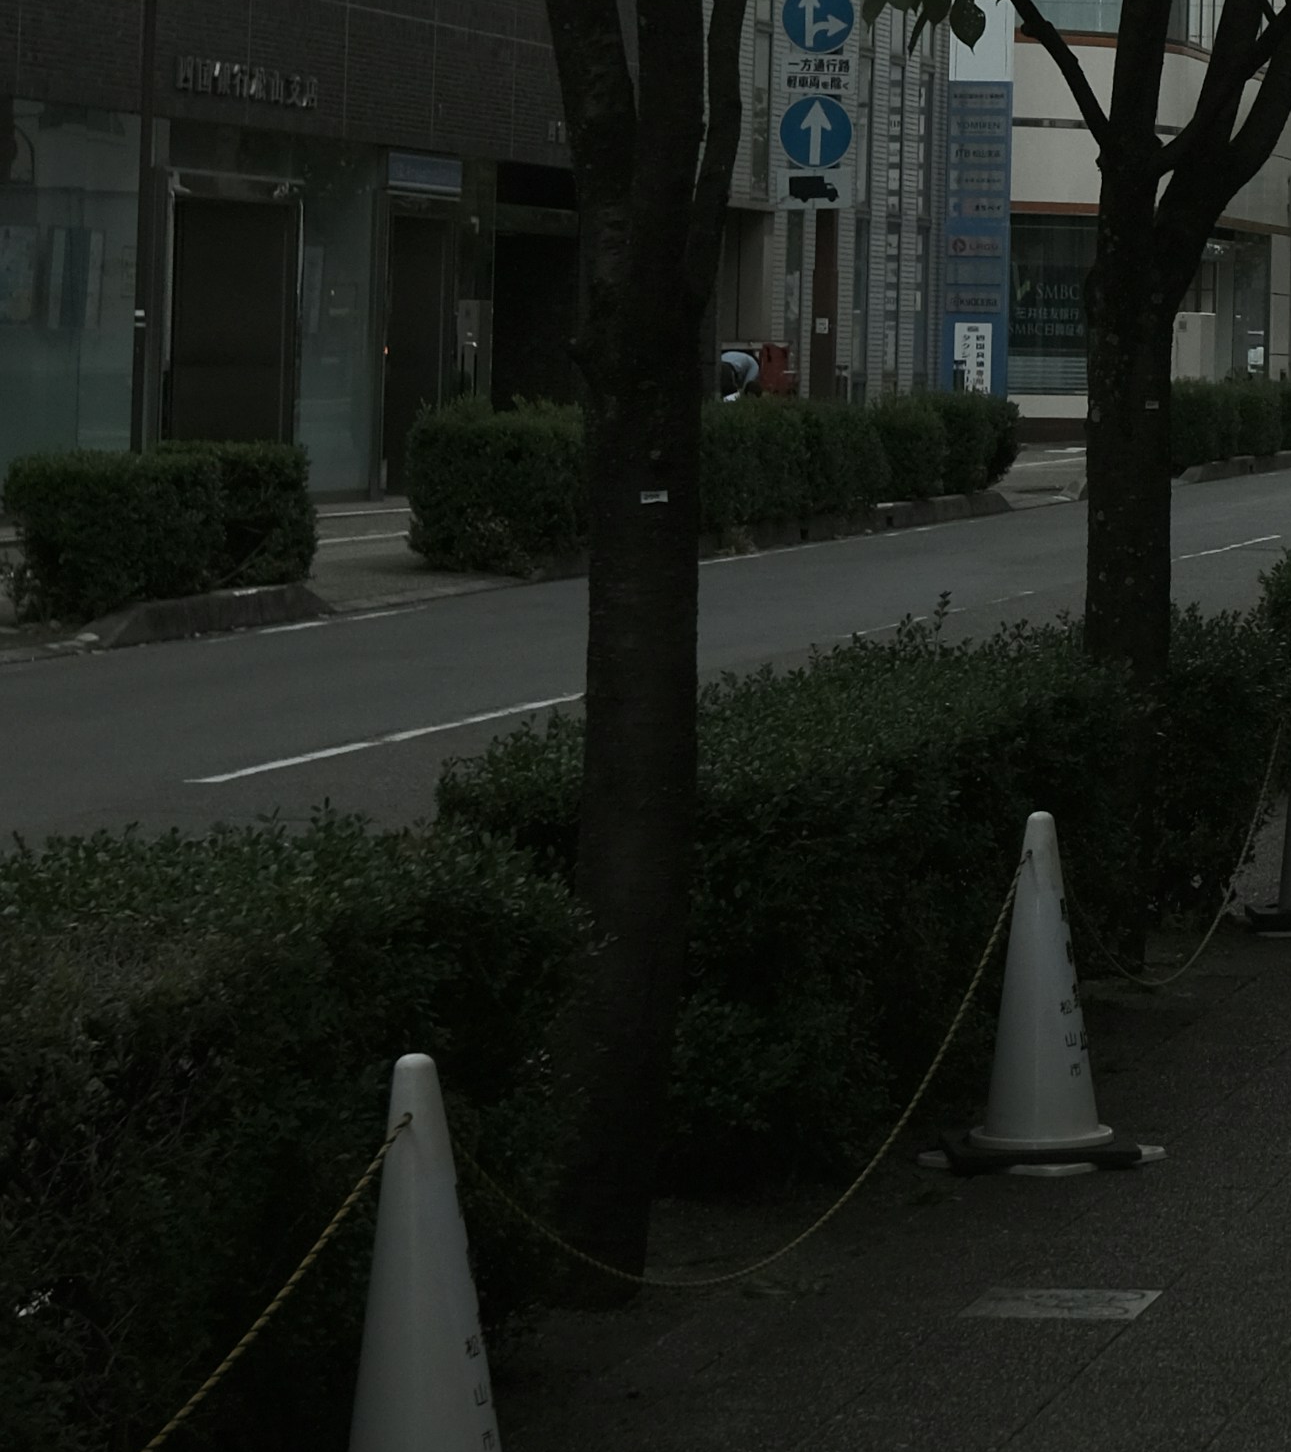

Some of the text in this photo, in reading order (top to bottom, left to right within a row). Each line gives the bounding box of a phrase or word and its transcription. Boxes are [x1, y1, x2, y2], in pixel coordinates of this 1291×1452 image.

[788, 58, 850, 73] 一方通行路
[1036, 282, 1080, 300] SMBC
[1060, 999, 1083, 1078] 松山市
